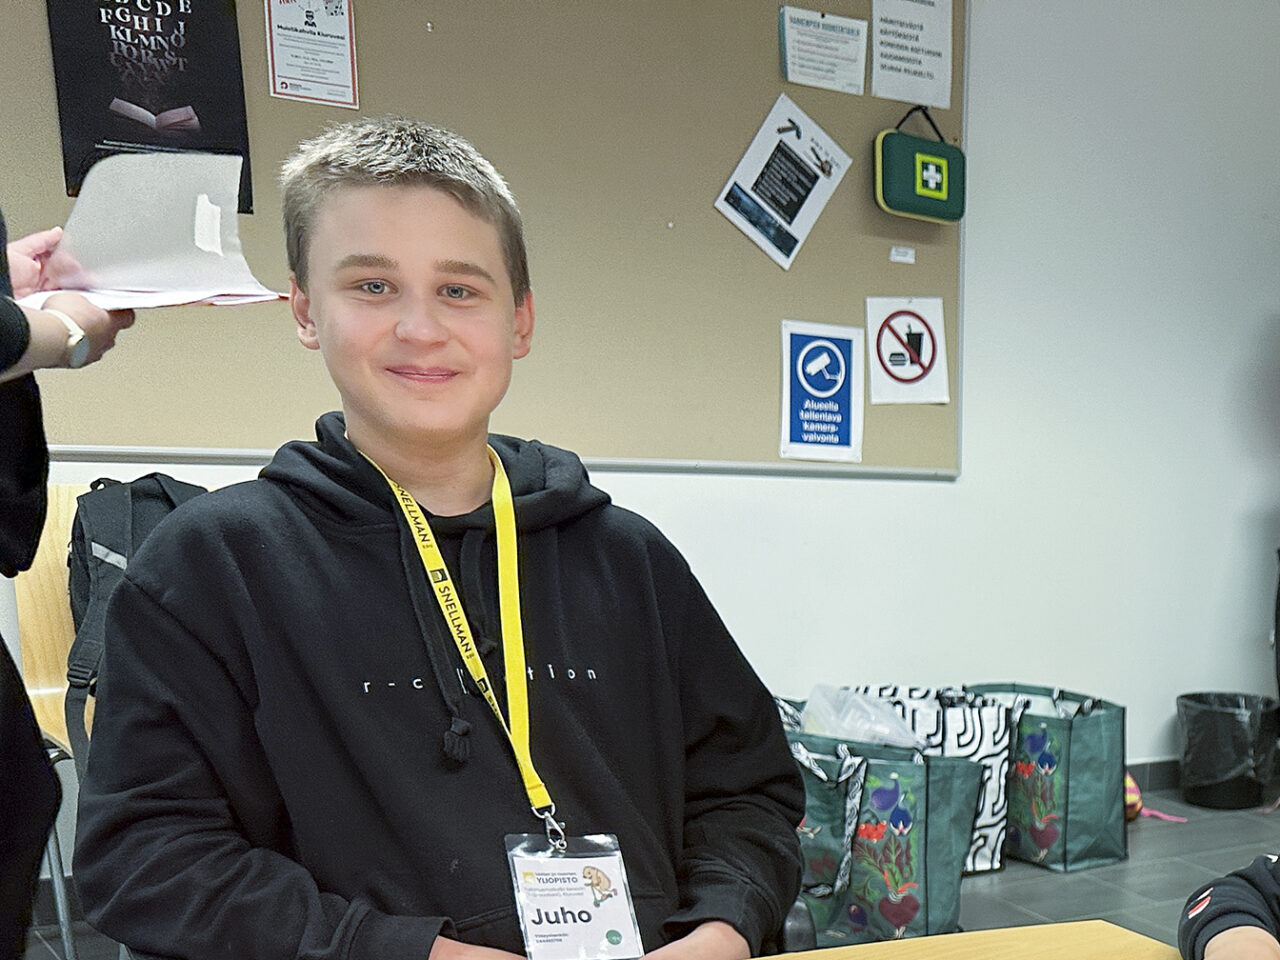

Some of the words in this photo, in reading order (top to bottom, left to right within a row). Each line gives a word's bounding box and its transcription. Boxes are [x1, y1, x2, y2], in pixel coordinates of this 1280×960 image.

[803, 399, 839, 412] Alueella
[799, 409, 842, 423] tallentava
[801, 432, 840, 444] valvonta
[438, 586, 472, 654] SNELLMAN
[536, 876, 579, 884] YLIOPISTO
[531, 906, 593, 925] Juho
